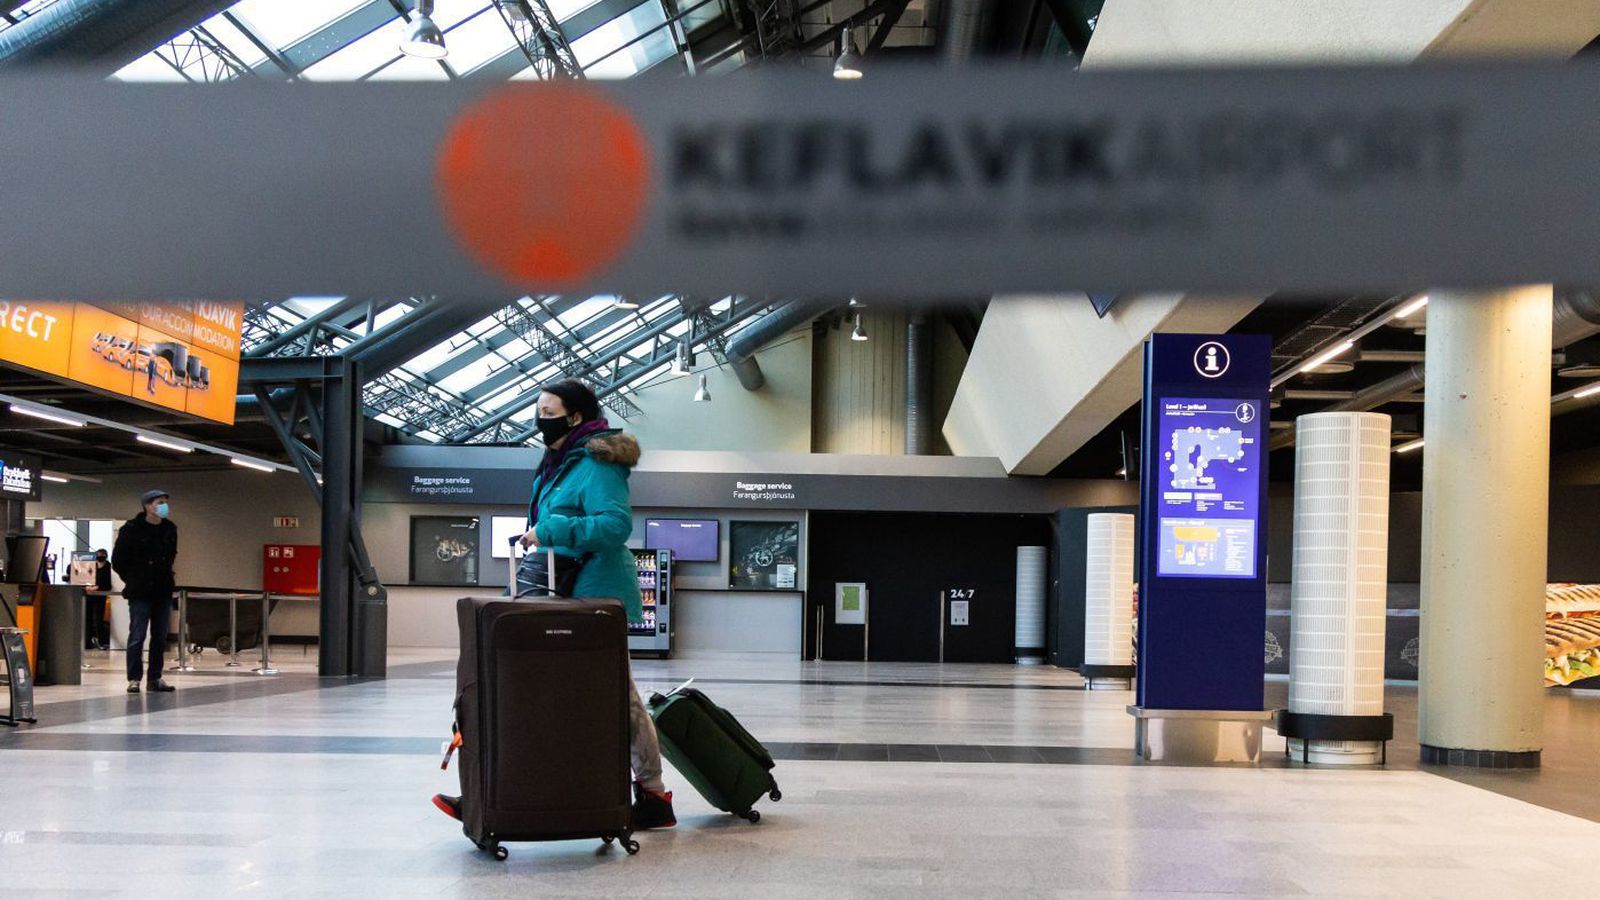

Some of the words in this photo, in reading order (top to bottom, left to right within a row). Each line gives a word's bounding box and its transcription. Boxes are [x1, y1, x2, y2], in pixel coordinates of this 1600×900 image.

[414, 475, 444, 485] Baggage
[736, 481, 766, 491] Baggage
[767, 482, 792, 490] service
